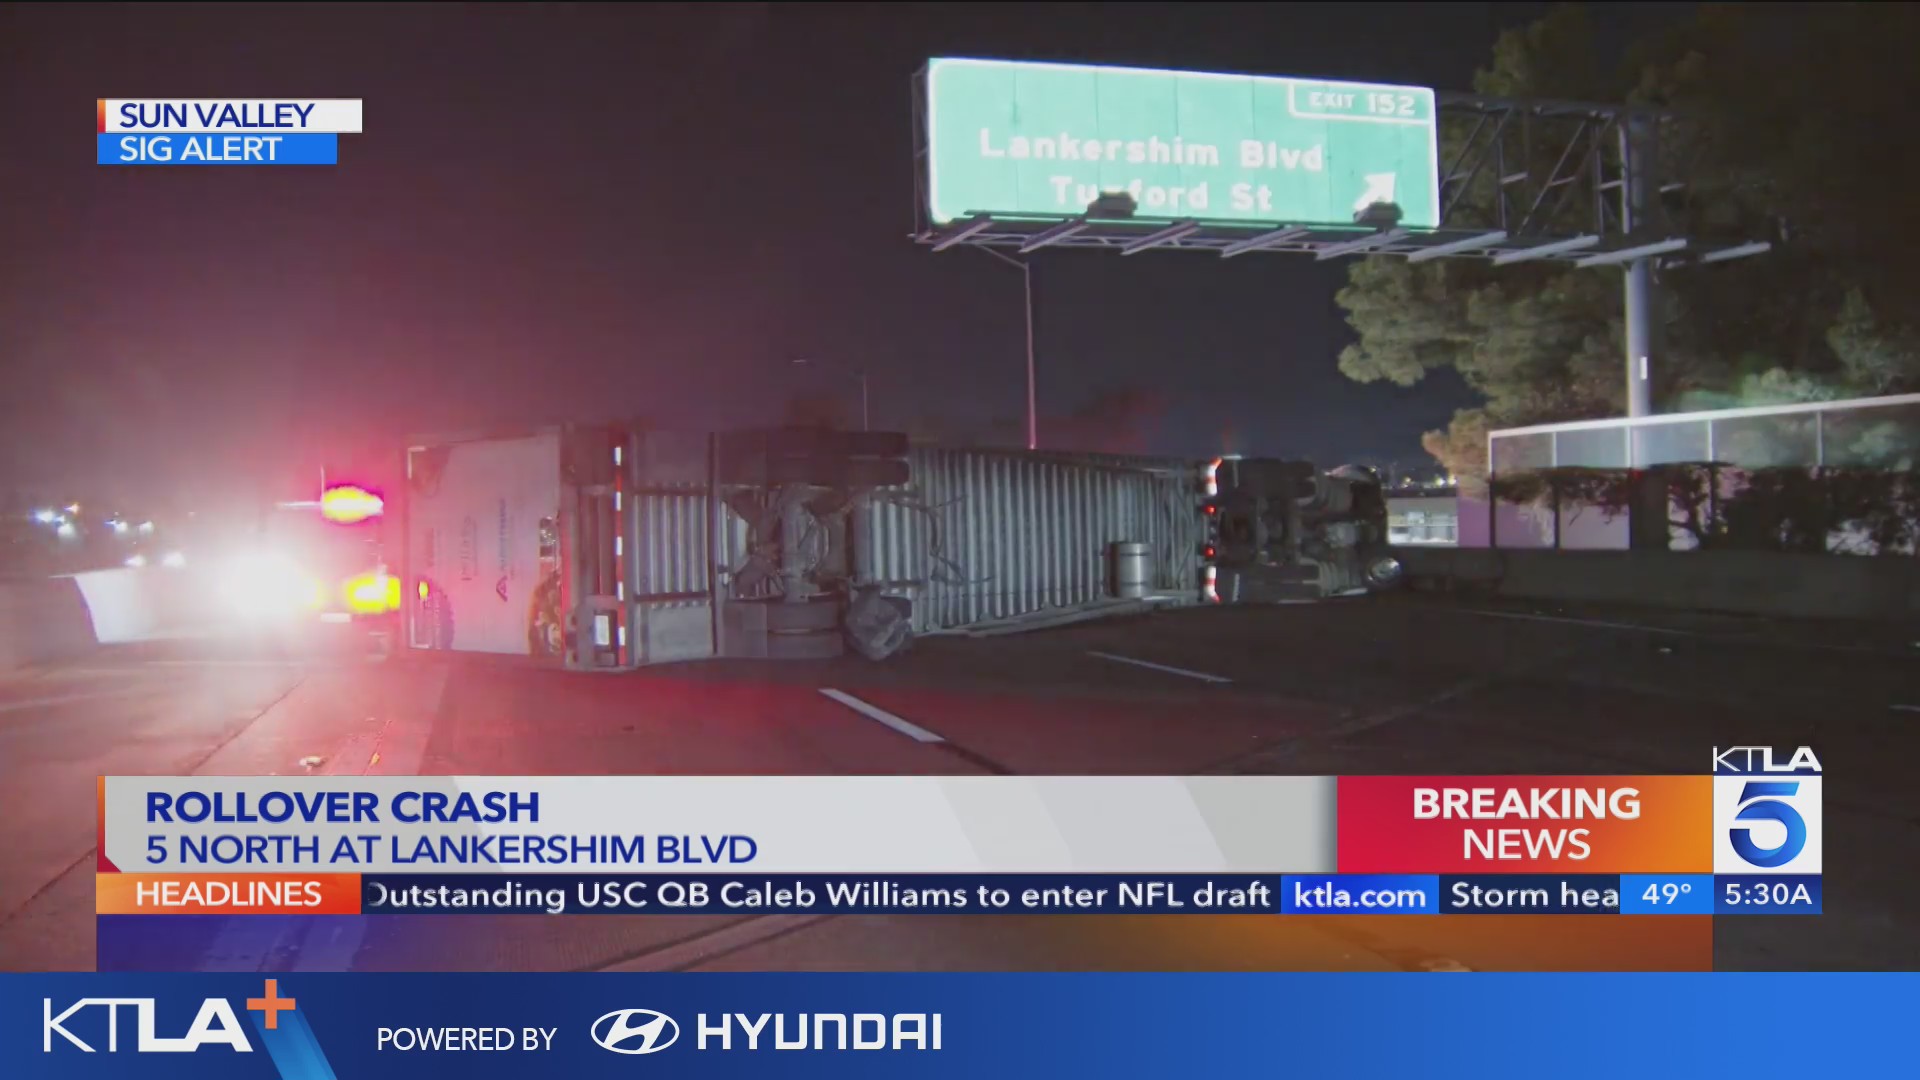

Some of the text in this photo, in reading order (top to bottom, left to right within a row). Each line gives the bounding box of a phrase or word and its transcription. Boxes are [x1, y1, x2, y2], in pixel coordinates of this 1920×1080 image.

[1309, 91, 1416, 116] EXIT 152
[979, 127, 1323, 172] Lankershim Blvd
[1049, 175, 1273, 212] Tuford St
